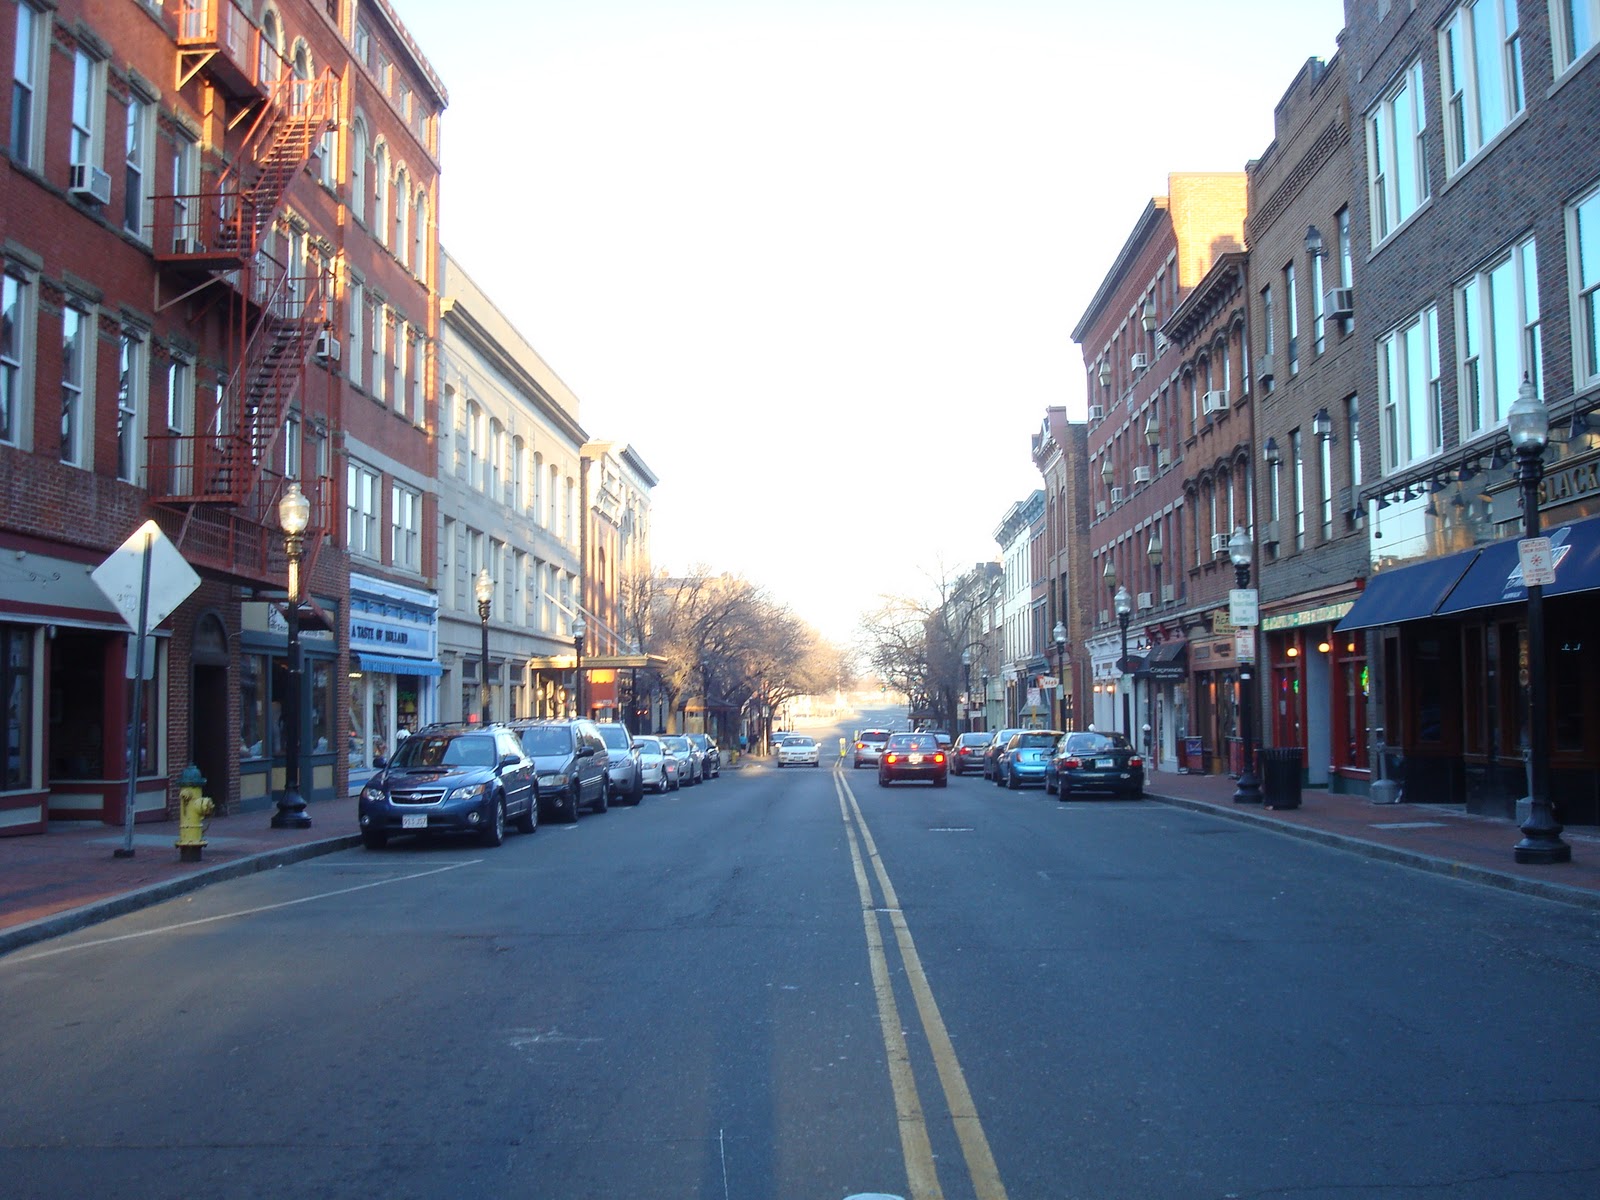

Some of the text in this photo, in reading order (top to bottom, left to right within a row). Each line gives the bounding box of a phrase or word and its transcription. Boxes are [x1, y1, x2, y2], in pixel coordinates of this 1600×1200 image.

[1537, 463, 1599, 505] BLACK
[351, 625, 408, 645] A TASTE OF HOLLAND
